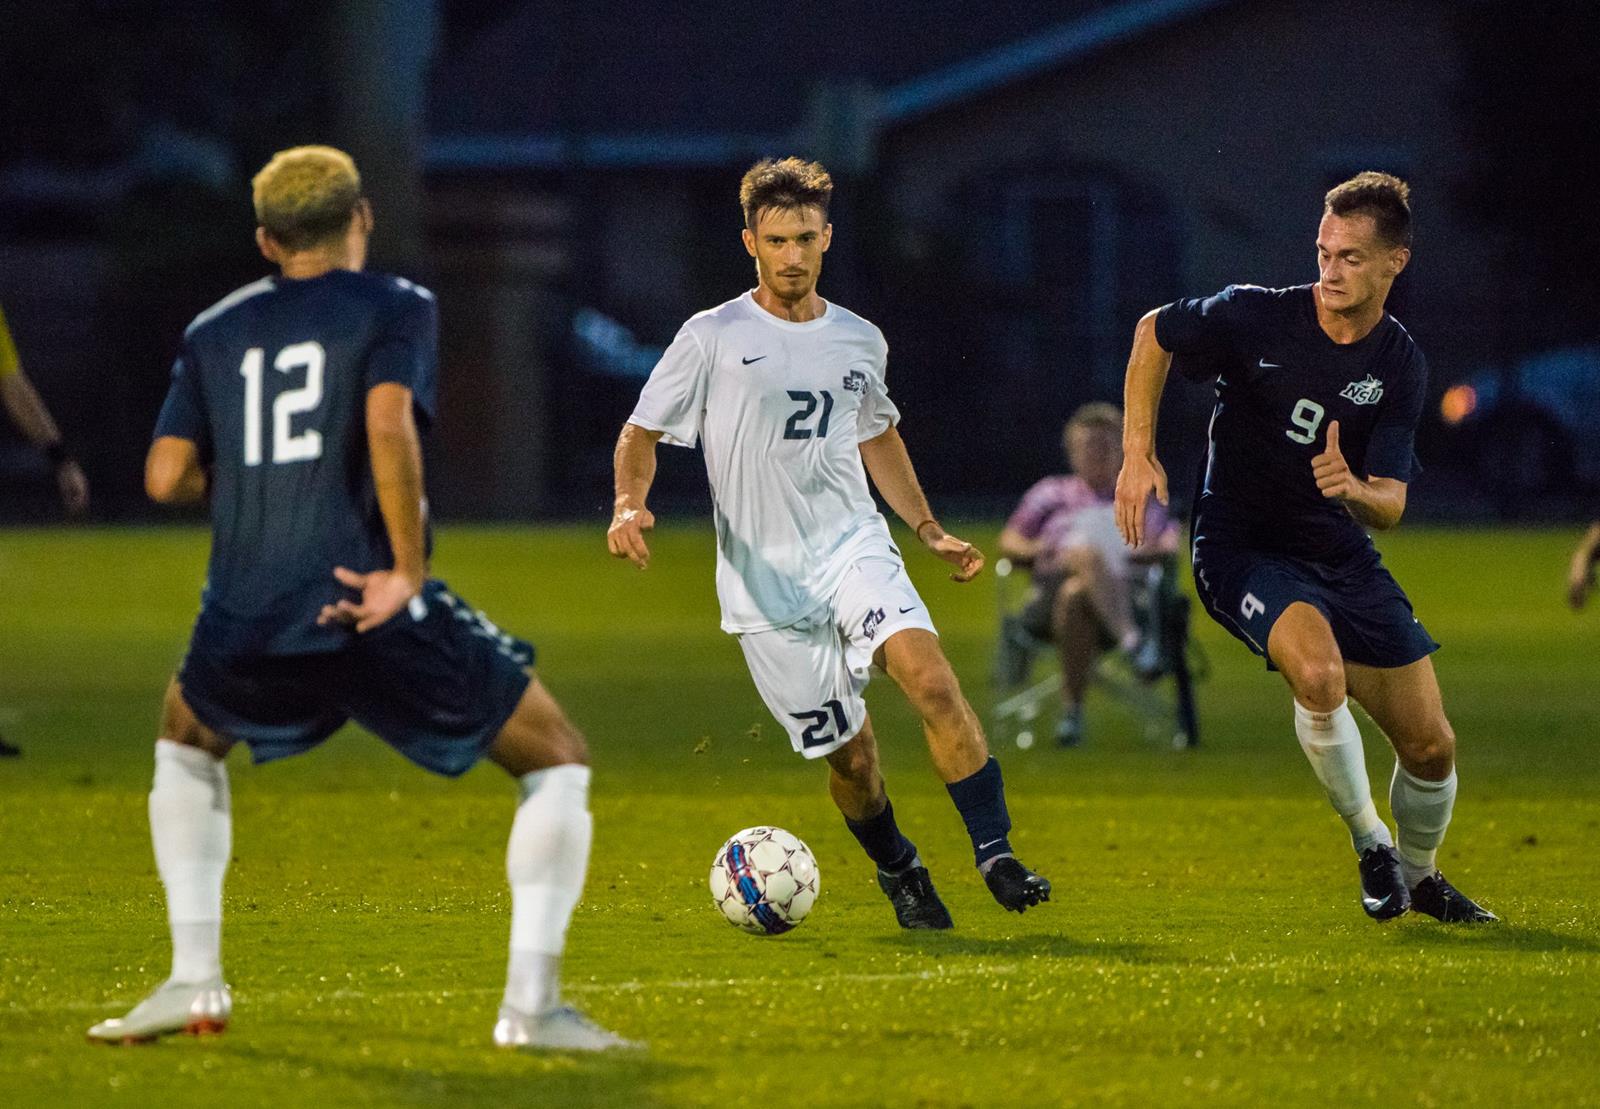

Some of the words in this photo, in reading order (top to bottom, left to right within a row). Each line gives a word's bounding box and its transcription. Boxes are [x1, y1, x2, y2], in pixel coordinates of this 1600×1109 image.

[239, 340, 326, 467] 12
[783, 390, 835, 440] 21
[1341, 383, 1383, 405] NSU
[1285, 398, 1325, 445] 9
[1240, 592, 1265, 620] 9
[788, 699, 849, 749] 21
